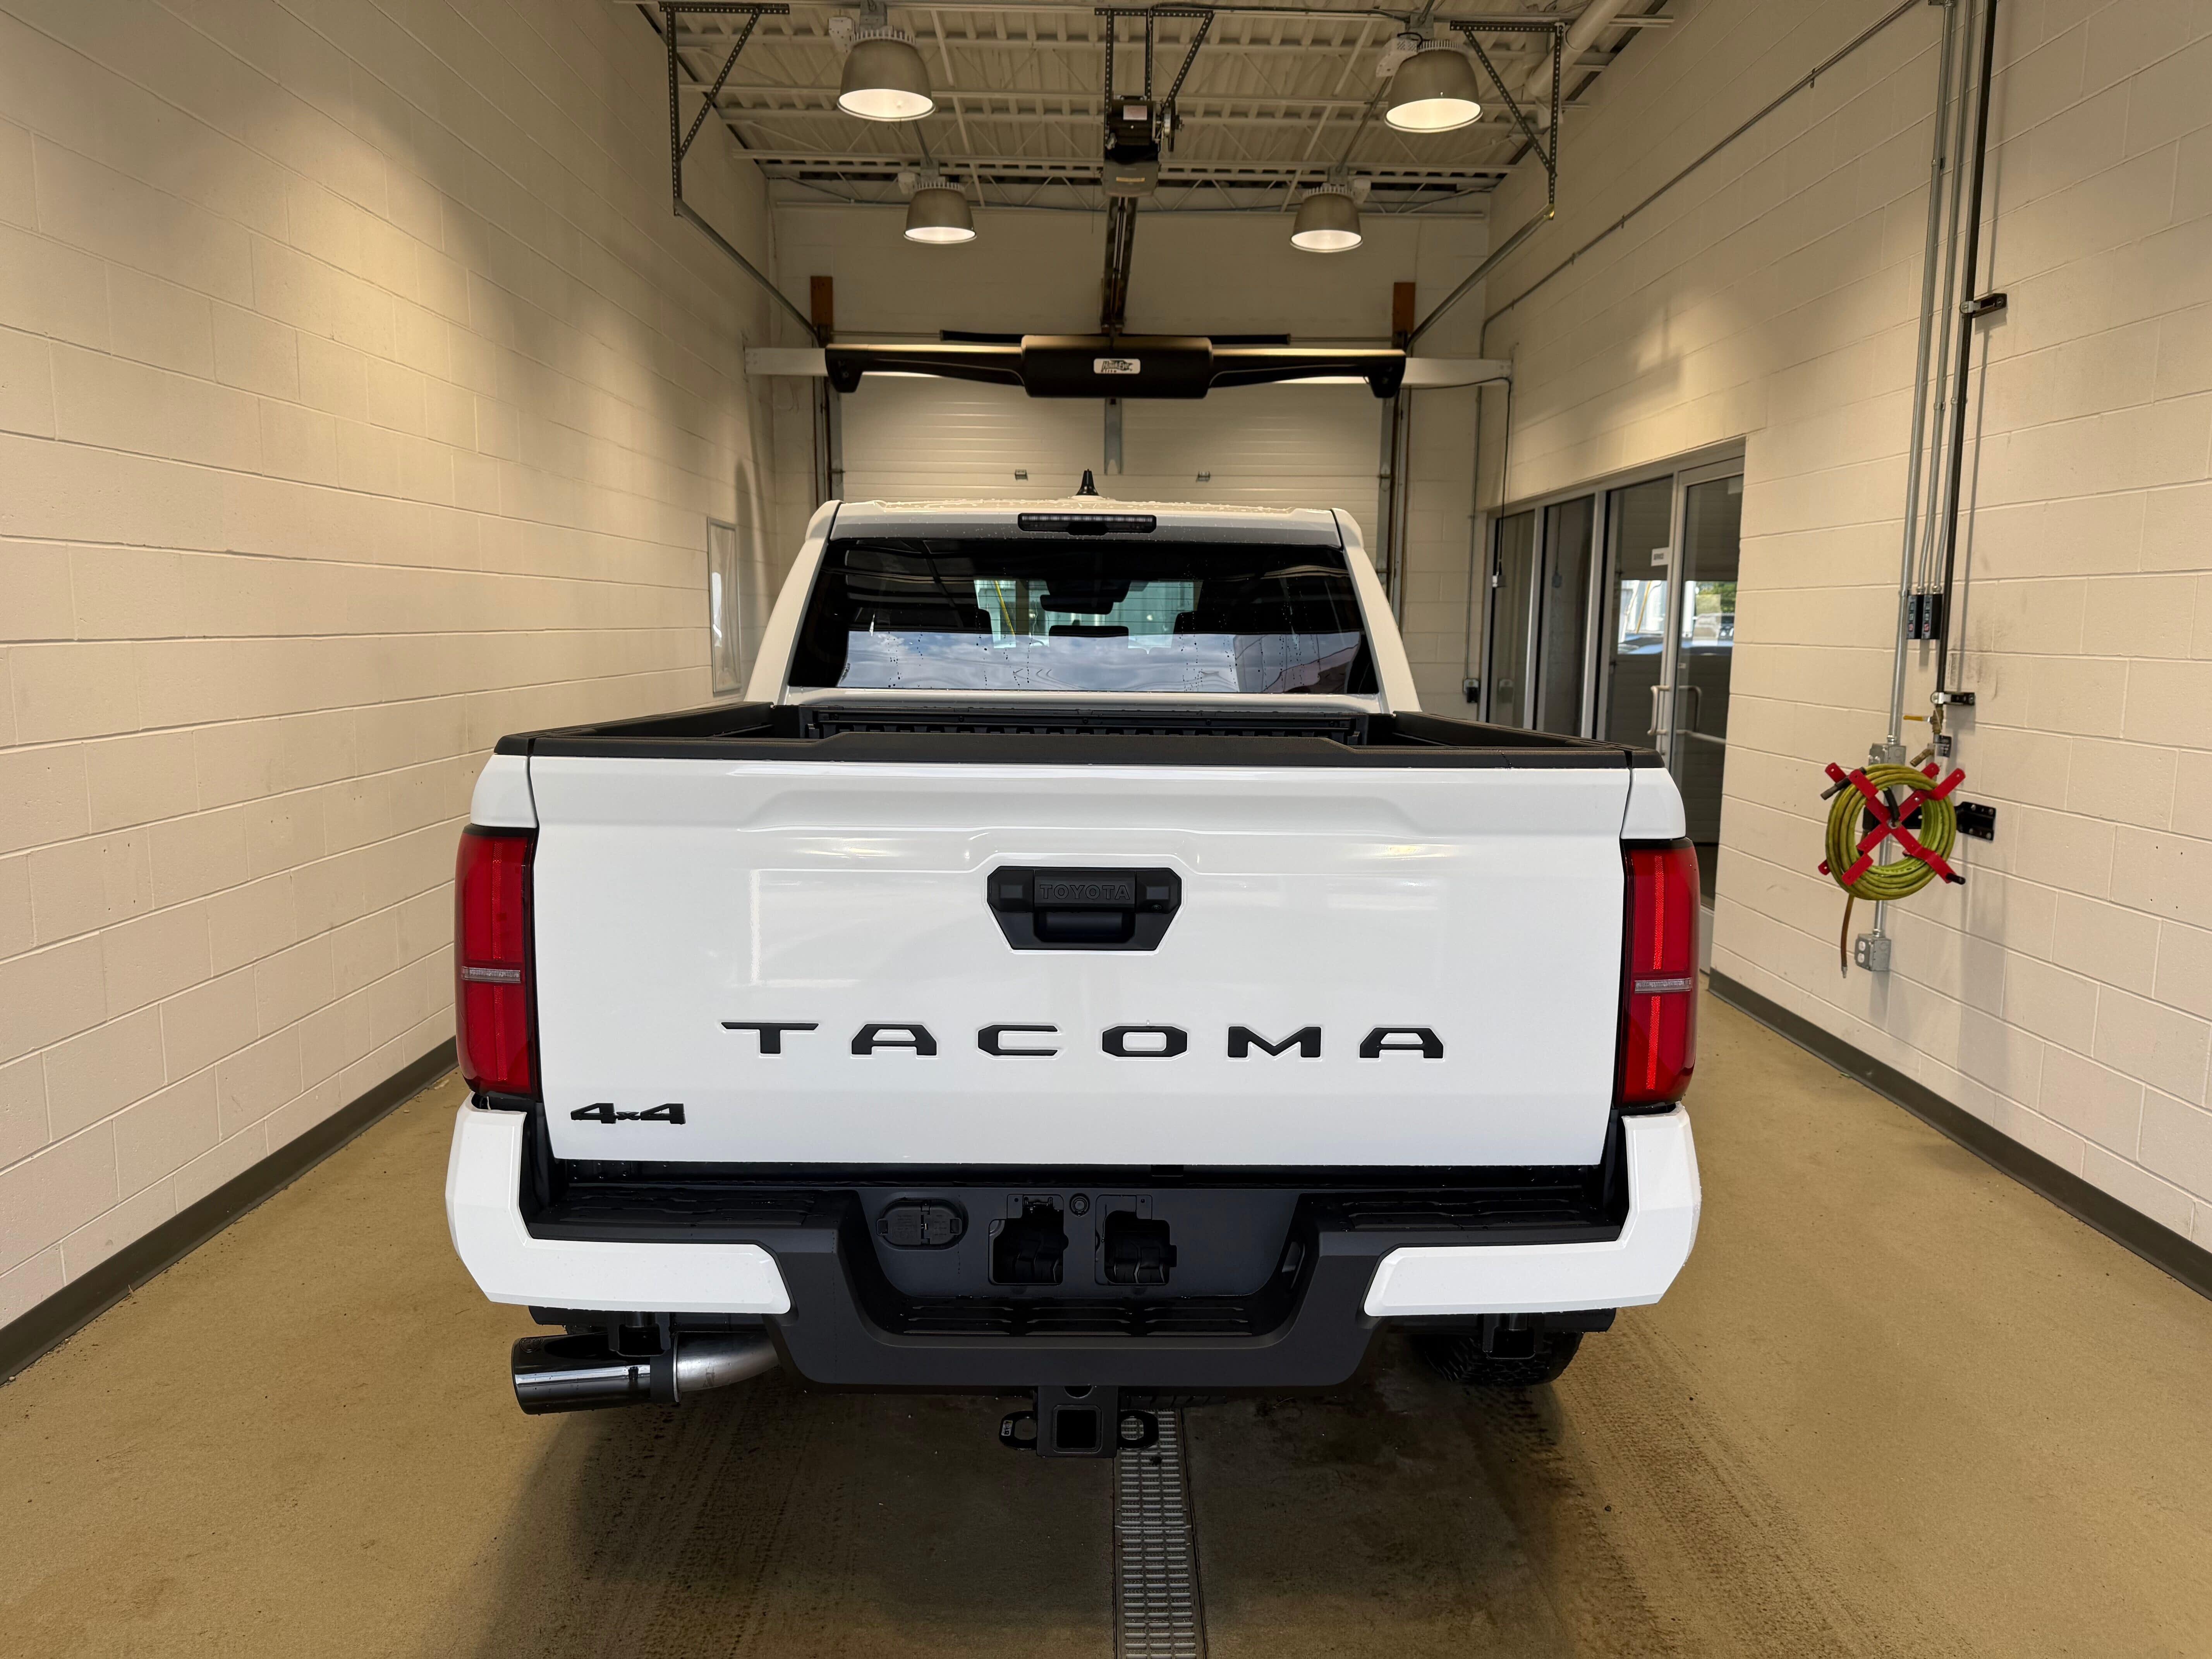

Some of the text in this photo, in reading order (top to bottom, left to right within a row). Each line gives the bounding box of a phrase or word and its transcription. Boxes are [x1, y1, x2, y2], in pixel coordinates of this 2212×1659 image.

[1039, 884, 1130, 900] TOYOTA
[721, 1022, 1444, 1059] TACOMA
[570, 1103, 686, 1125] 4x4
